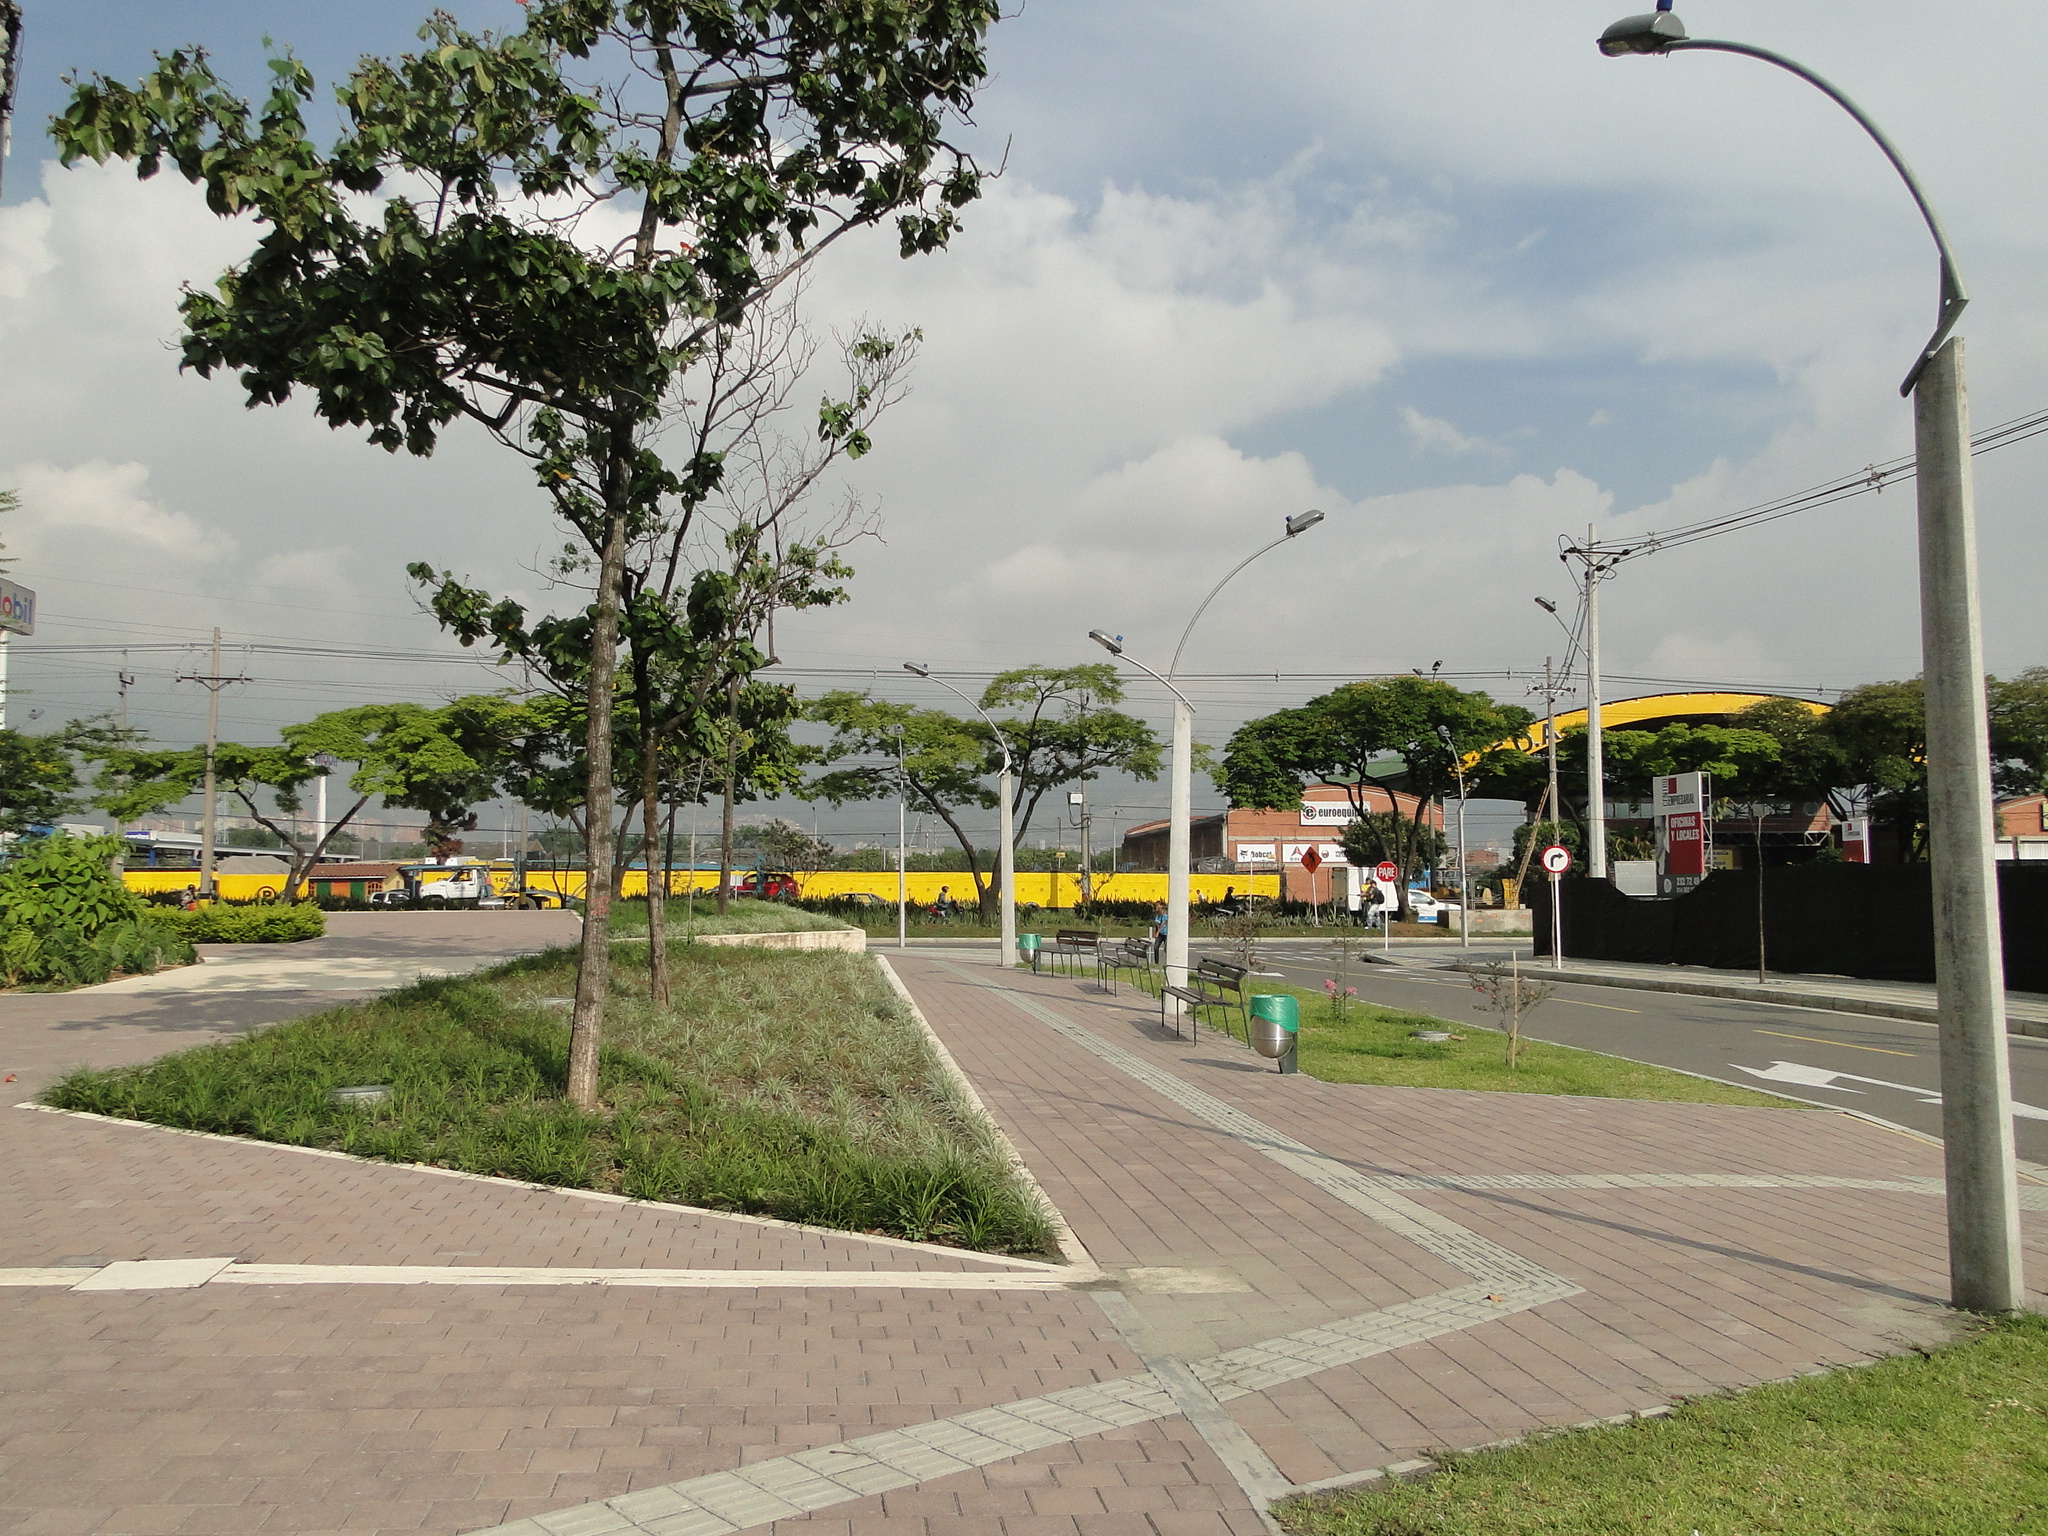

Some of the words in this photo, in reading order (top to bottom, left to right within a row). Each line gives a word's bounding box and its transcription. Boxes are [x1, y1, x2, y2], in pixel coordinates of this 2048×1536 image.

[0, 587, 32, 625] obil
[1670, 816, 1696, 828] OFICINAS
[1676, 829, 1699, 841] LOCALES
[1378, 867, 1395, 877] PARE
